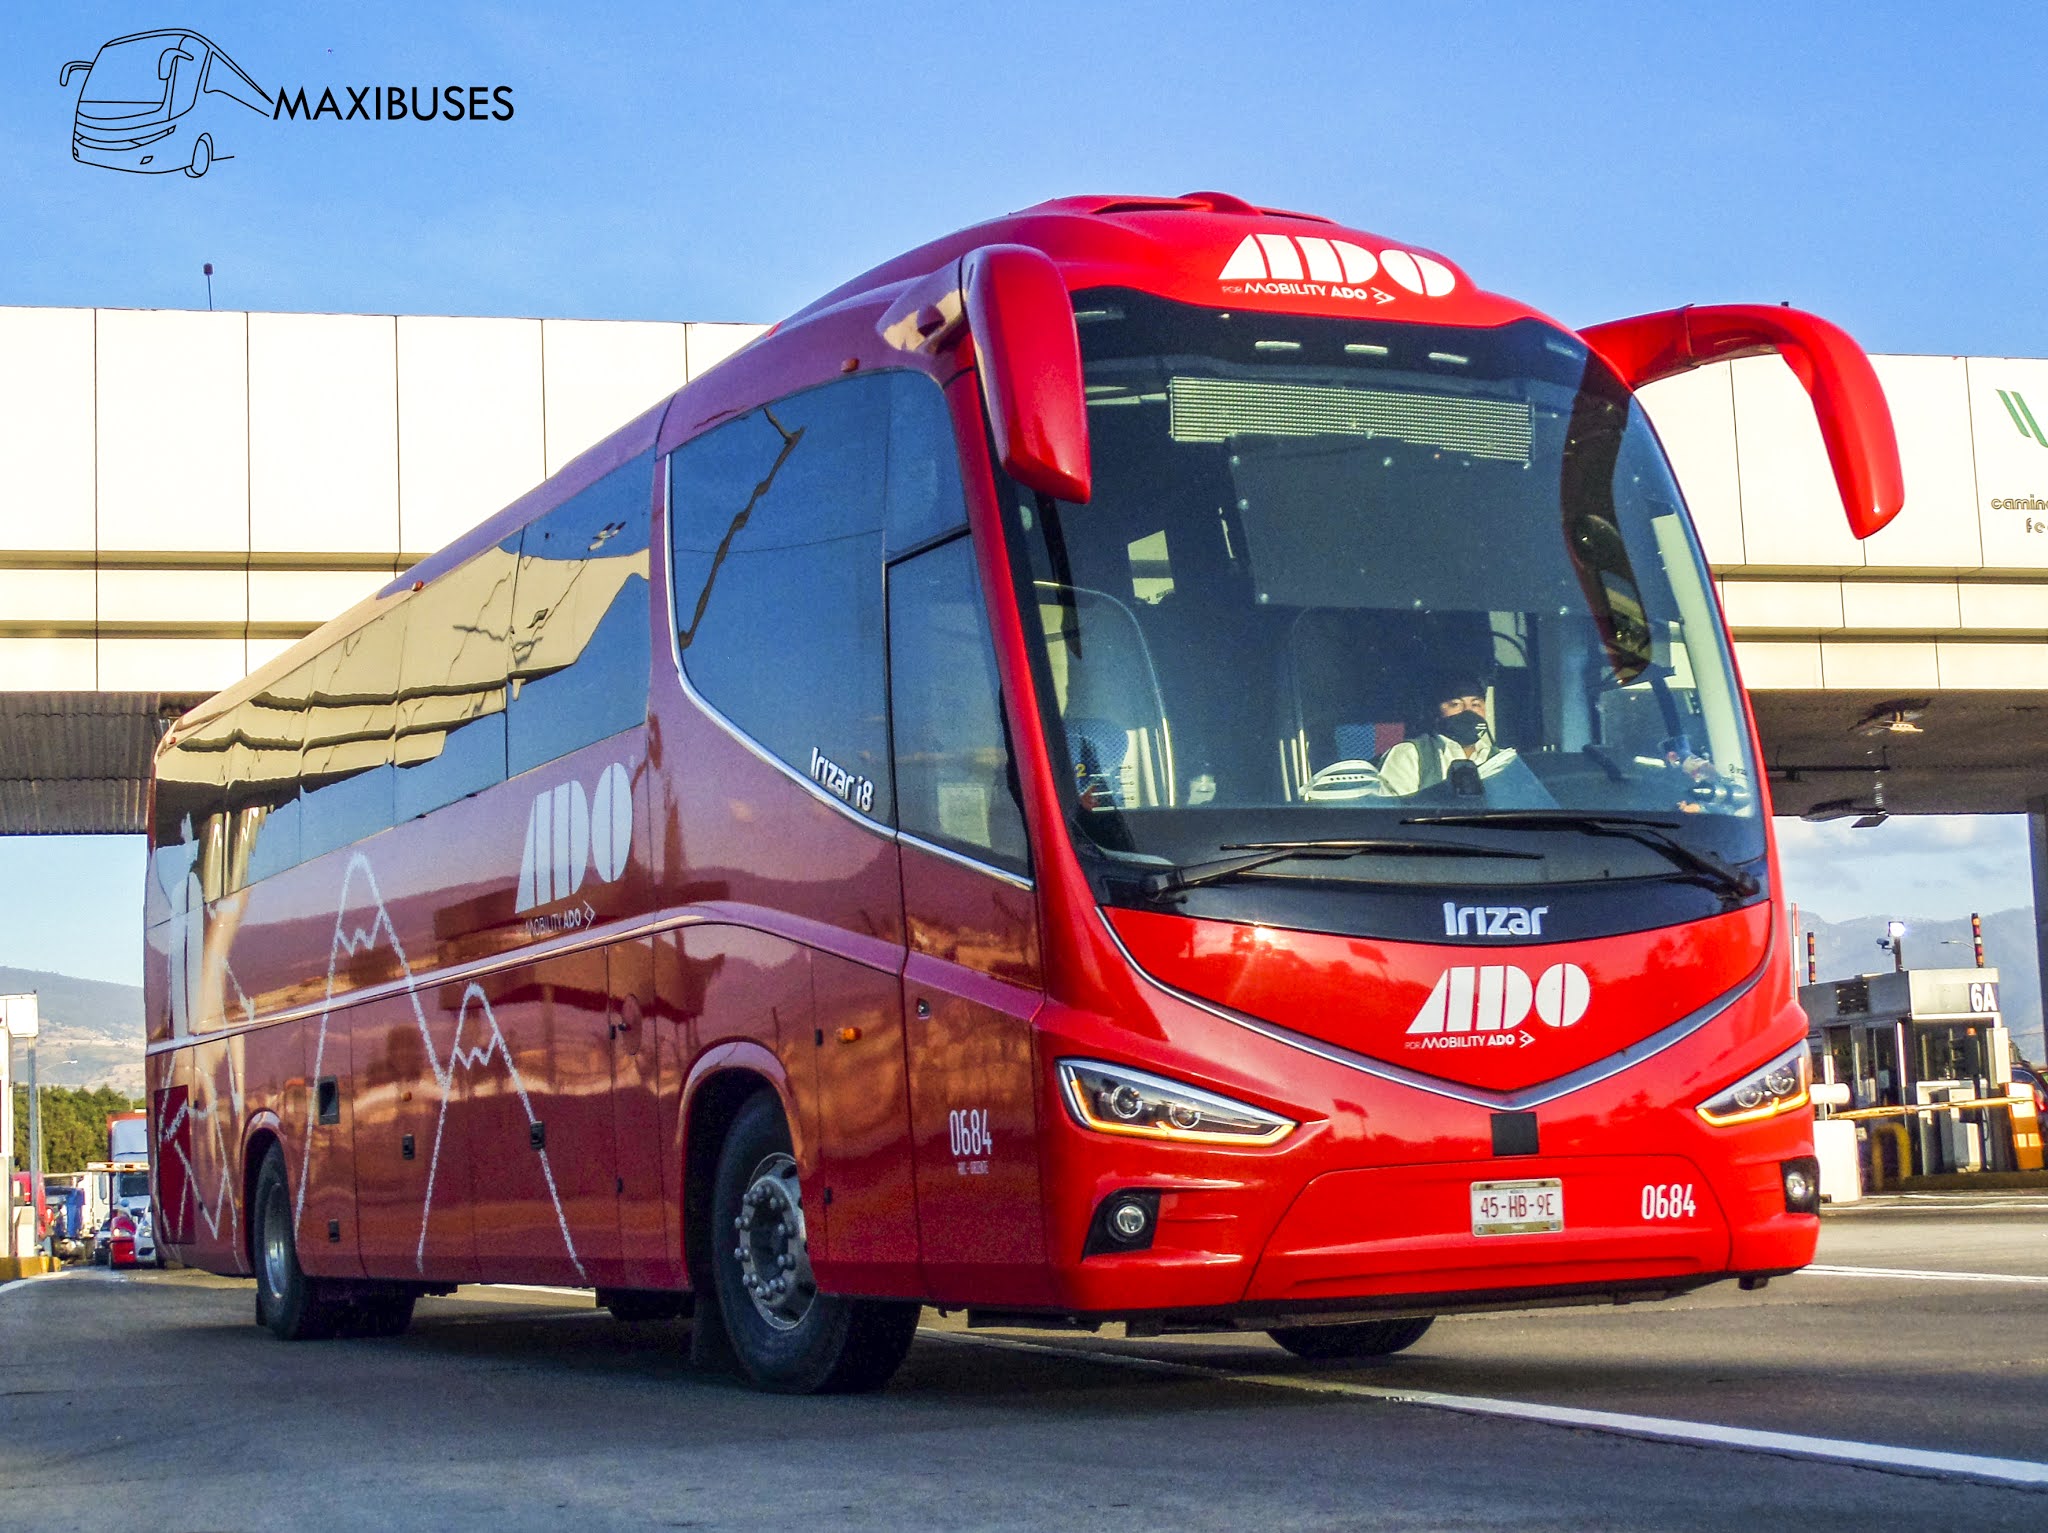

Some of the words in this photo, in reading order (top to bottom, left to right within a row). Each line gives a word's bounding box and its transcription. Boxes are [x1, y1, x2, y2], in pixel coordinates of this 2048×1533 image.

[1218, 233, 1456, 297] ADO
[1244, 282, 1326, 296] MOBILITY
[1331, 286, 1367, 300] ADO
[1991, 494, 2048, 510] camin
[810, 746, 855, 800] Irizar
[856, 775, 874, 812] i8
[514, 762, 633, 914] ADO
[525, 913, 561, 937] MOBILITY
[563, 908, 581, 928] ADO
[1443, 902, 1548, 935] Irizar
[1405, 963, 1591, 1034] ADO
[1970, 983, 1998, 1012] 6A
[1421, 1035, 1486, 1049] MOBILITY
[1487, 1033, 1515, 1046] ADO
[949, 1109, 992, 1156] 0684
[1481, 1193, 1555, 1218] 45-HB-9E
[1641, 1183, 1697, 1220] 0684
